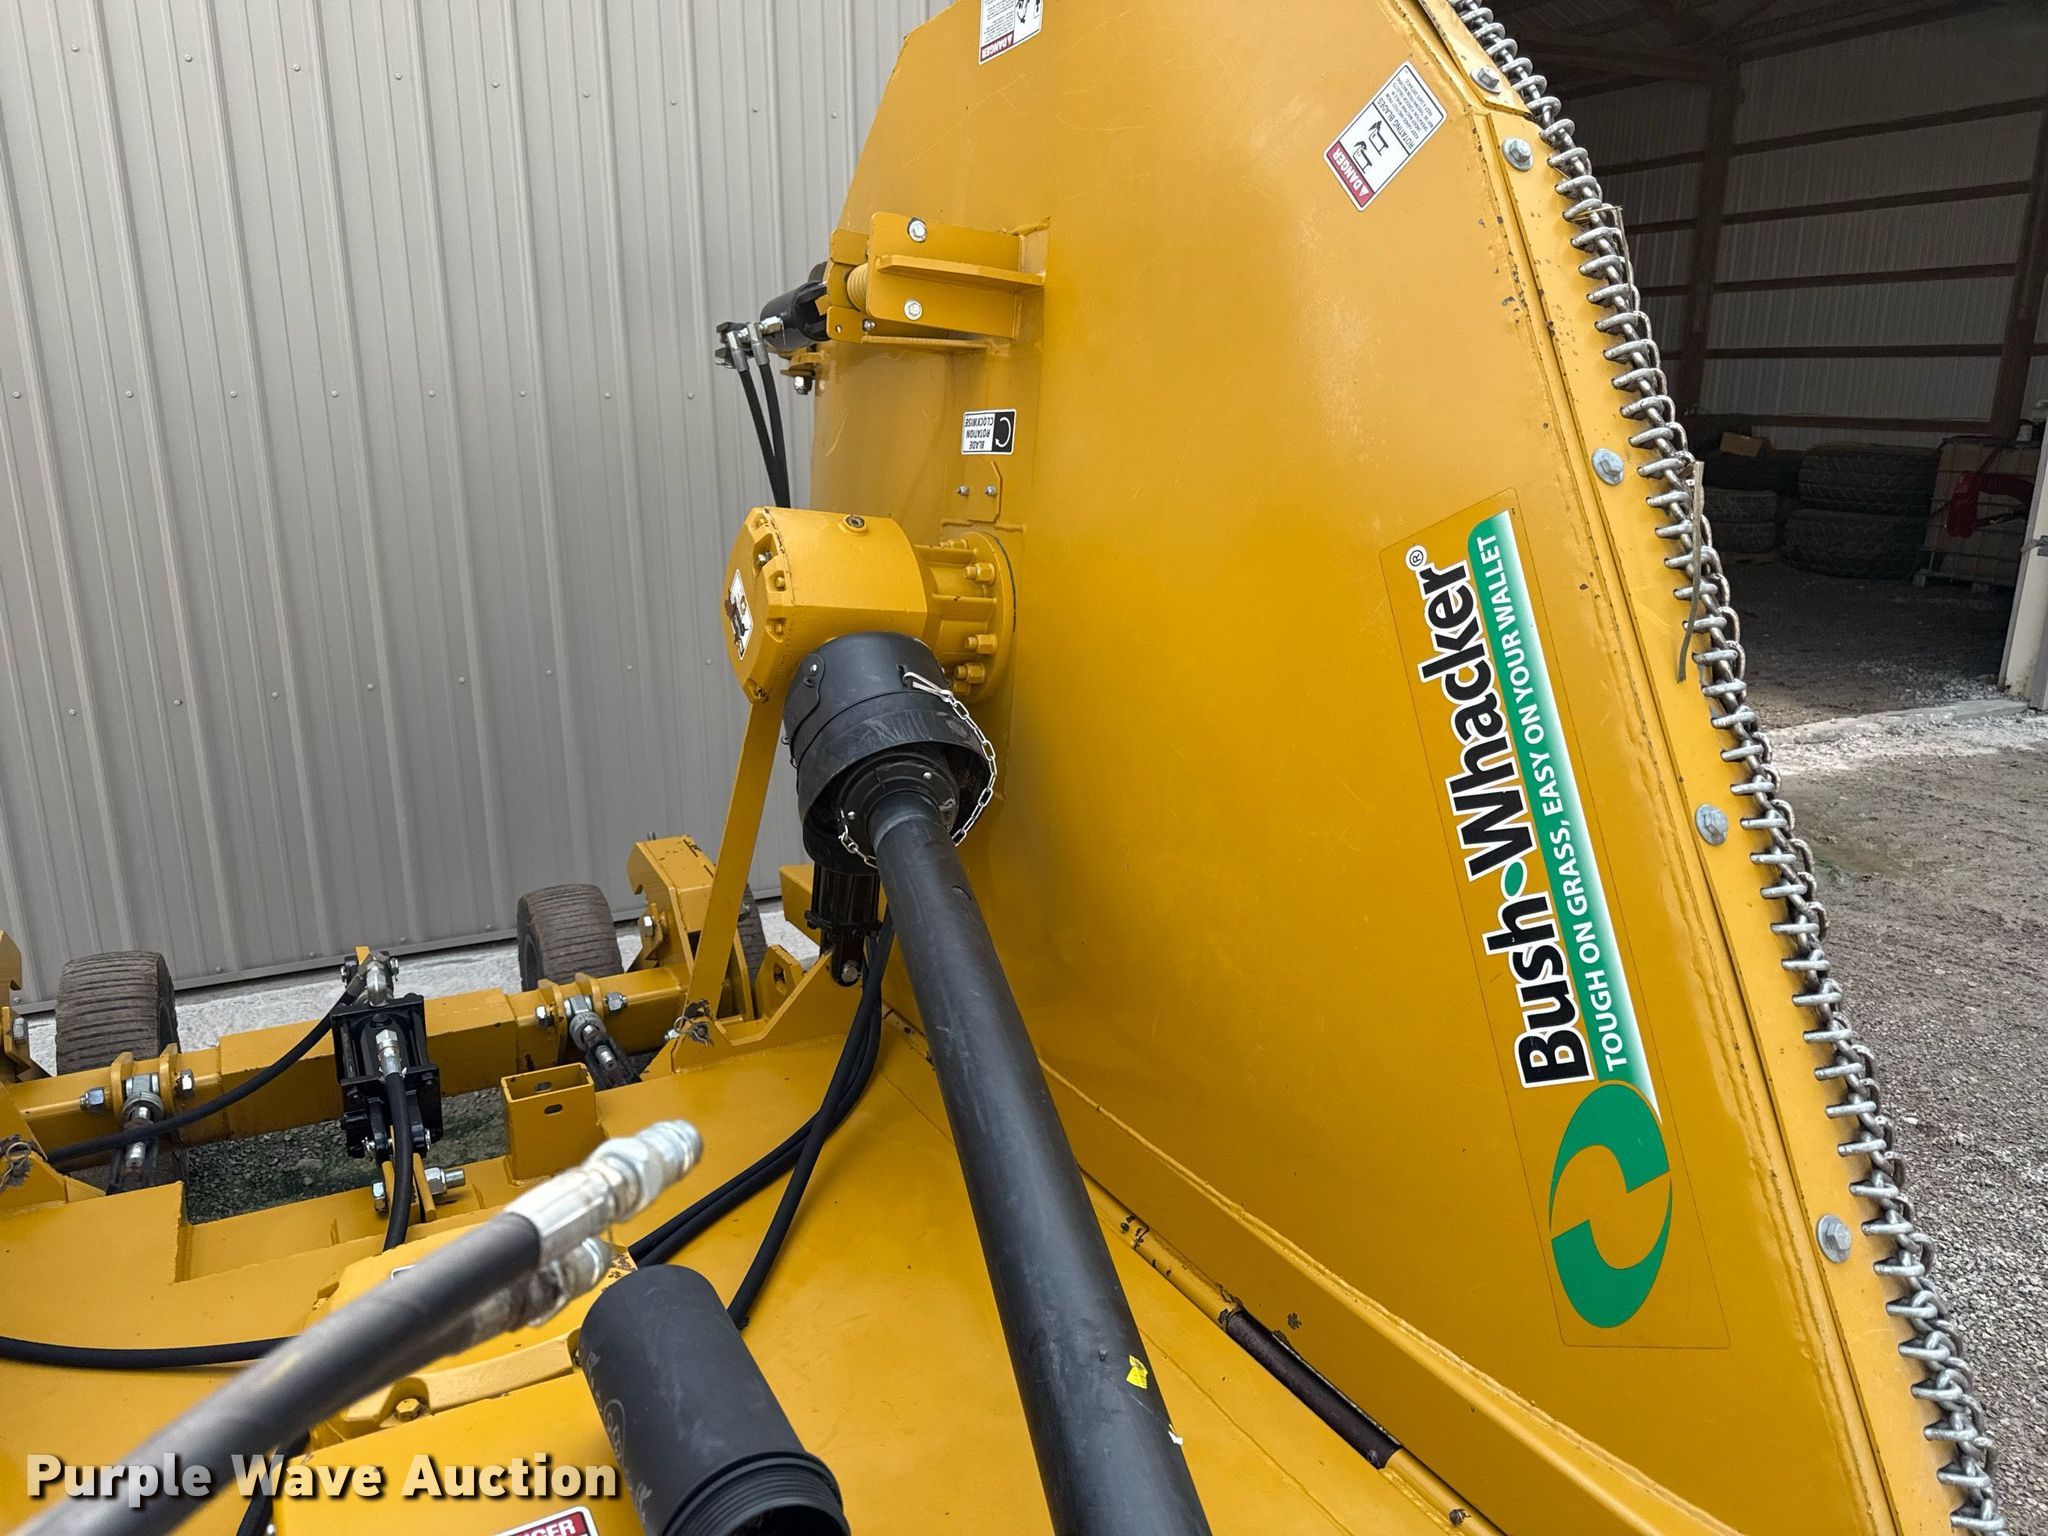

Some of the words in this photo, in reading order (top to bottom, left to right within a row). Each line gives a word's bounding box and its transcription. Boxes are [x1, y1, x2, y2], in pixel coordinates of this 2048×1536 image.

[1376, 96, 1395, 122] BLADES
[1391, 118, 1415, 149] ROTATING
[1331, 147, 1363, 191] DANGER
[965, 417, 993, 427] CLOCKWISE
[966, 429, 990, 438] ROTATION
[969, 440, 985, 449] BLADE
[1477, 534, 1516, 632] WALLET
[1501, 629, 1535, 704] YOUR
[1519, 705, 1545, 745] ON
[1529, 752, 1564, 817] EASY
[1550, 819, 1588, 916] GRASS,
[1575, 922, 1601, 965] ON
[1585, 969, 1627, 1072] TOUGH
